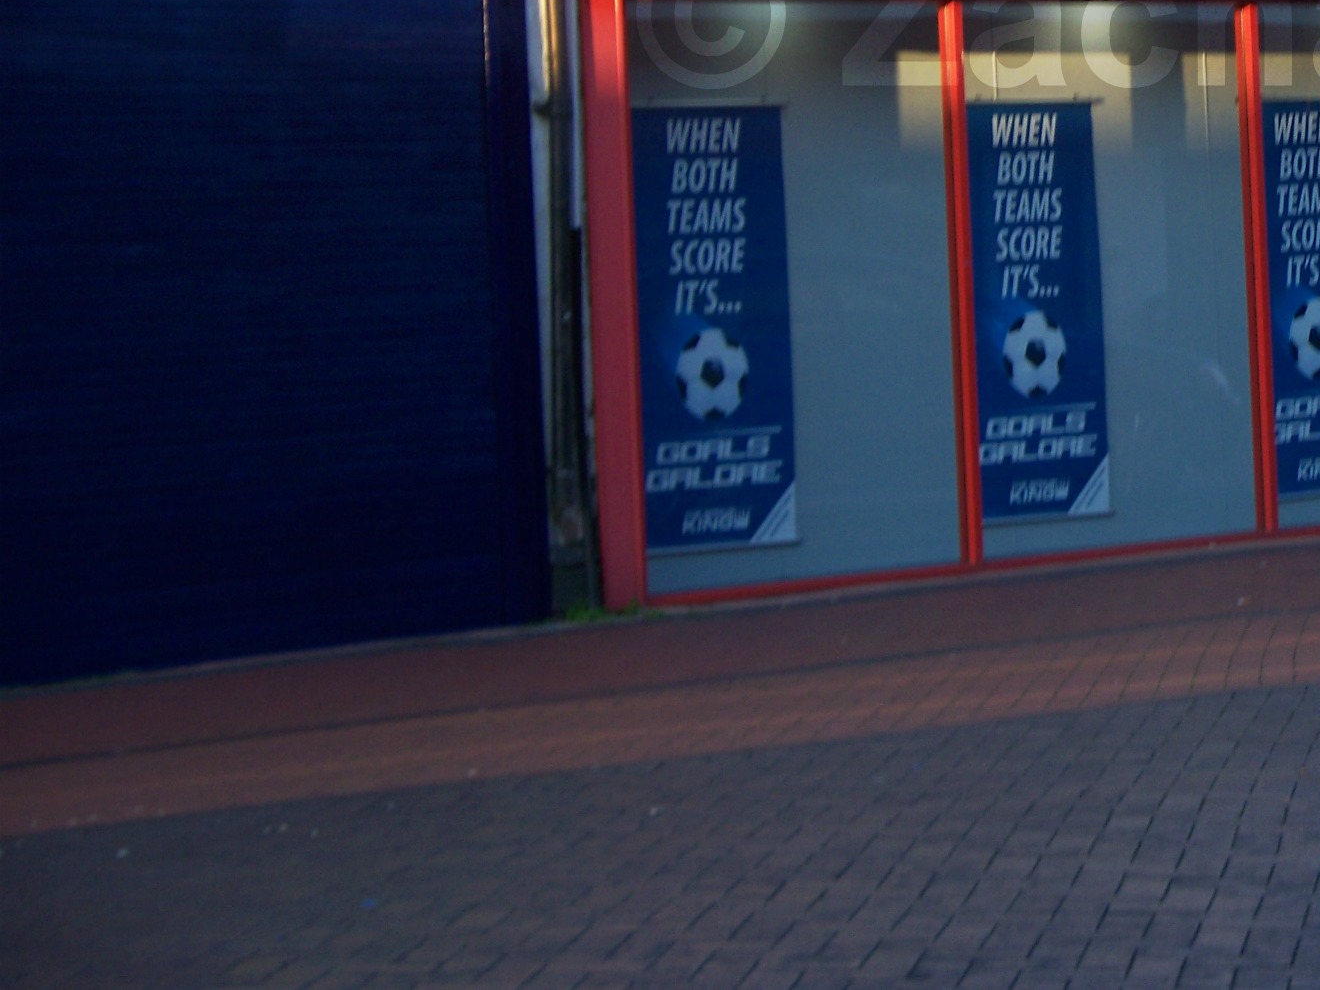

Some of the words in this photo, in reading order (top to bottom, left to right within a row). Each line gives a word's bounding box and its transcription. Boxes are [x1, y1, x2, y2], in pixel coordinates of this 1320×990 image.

[667, 117, 741, 155] WHEN
[992, 111, 1057, 149] WHEN
[671, 157, 738, 195] BOTH
[997, 150, 1055, 186] BOTH
[667, 197, 746, 235] TEAMS
[993, 187, 1063, 225] TEAMS
[669, 236, 746, 276] SCORE
[995, 225, 1063, 262] SCORE
[674, 278, 742, 317] IT'S...
[1001, 264, 1059, 300] IT'S...
